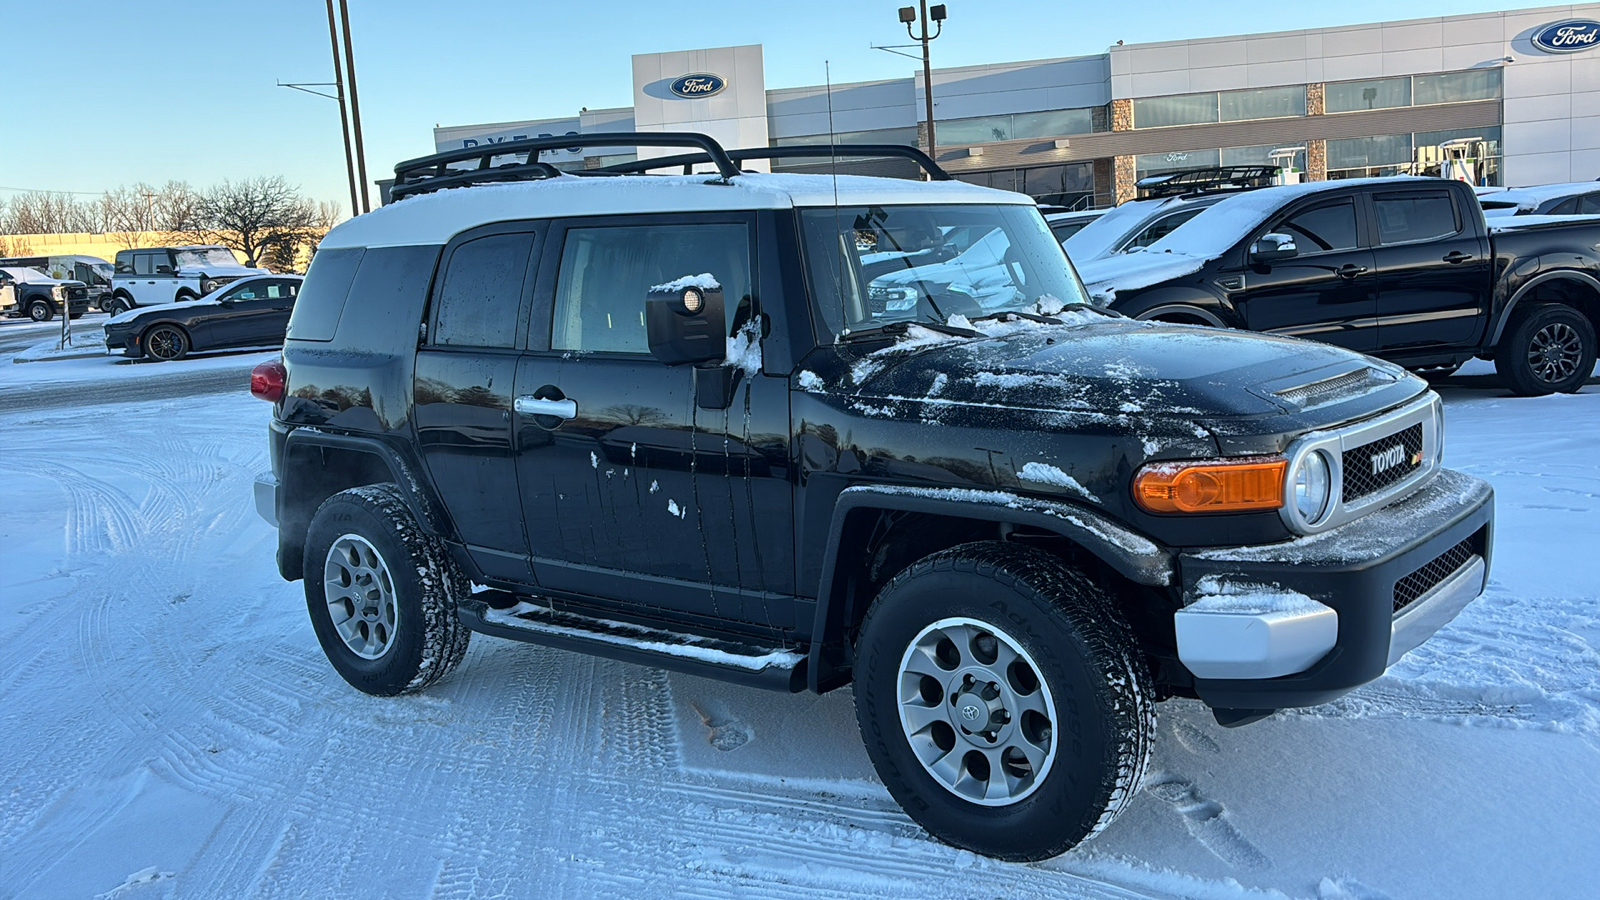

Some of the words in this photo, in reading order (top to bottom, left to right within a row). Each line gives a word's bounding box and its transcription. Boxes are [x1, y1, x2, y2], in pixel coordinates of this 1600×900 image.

[1552, 25, 1598, 46] Ford
[682, 78, 713, 93] Ford
[1166, 152, 1188, 162] Ford
[1371, 444, 1405, 476] TOYOTA
